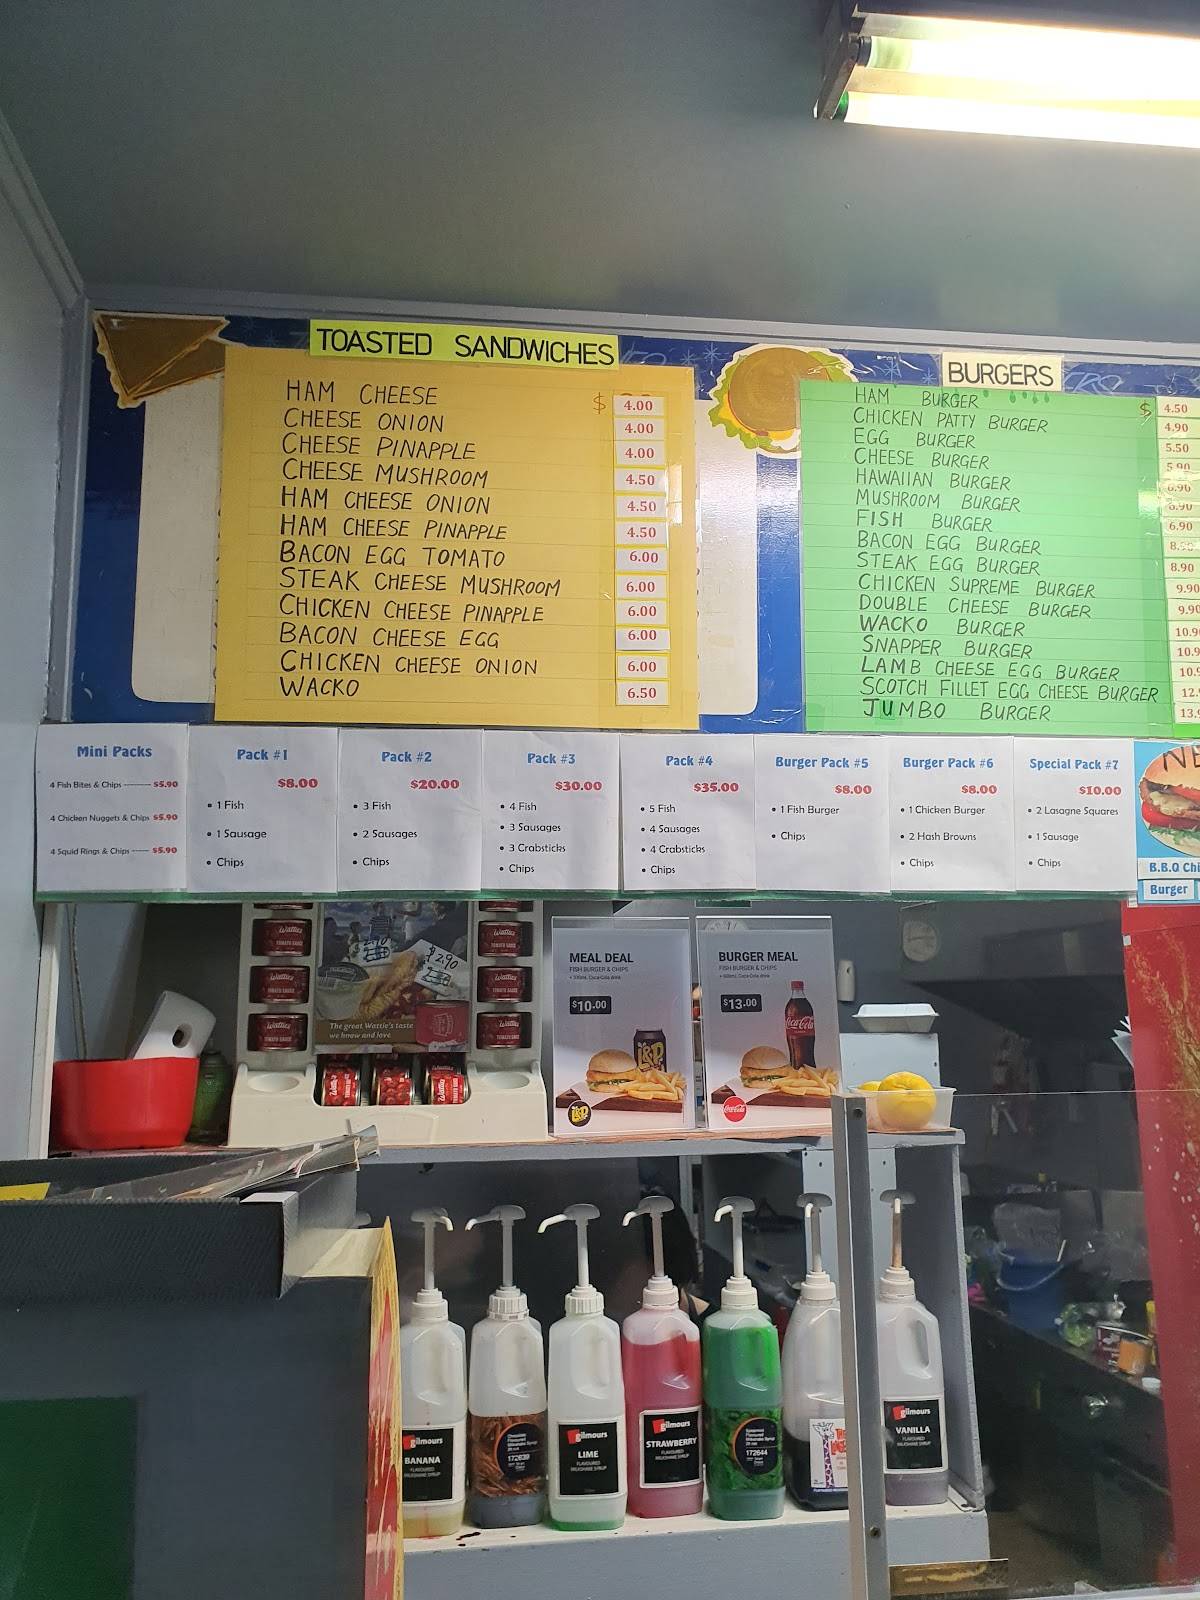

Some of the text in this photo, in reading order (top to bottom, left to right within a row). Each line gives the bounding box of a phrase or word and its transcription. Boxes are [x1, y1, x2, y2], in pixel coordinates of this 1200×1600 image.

[317, 328, 432, 355] TOASTED
[455, 335, 615, 365] SANDWICHES
[949, 362, 1053, 386] BURGERS
[287, 379, 438, 405] HAM CHEESE
[855, 387, 979, 408] HAM BURGER
[593, 393, 606, 414] $
[624, 400, 653, 412] 4.00
[1164, 404, 1188, 413] 4.50
[284, 408, 444, 432] CHEESE ONION
[853, 407, 1048, 432] CHICKEN PATTY BURGER
[624, 422, 653, 434] 4.00
[1165, 423, 1188, 432] 4.90
[854, 428, 975, 448] EGG BURGER
[1166, 444, 1189, 452] 5.50
[856, 468, 1011, 490] HAWAIIAN BURGER
[281, 485, 490, 514] HAM CHEESE ONION
[855, 489, 1020, 512] MUSHROOM BURGER
[626, 500, 656, 513] 4.50
[857, 509, 992, 532] FISH BURGER
[1169, 522, 1193, 531] 6.90
[280, 540, 505, 569] BACON EGG TOMATO
[629, 551, 659, 564] 6.00
[1171, 563, 1194, 572] 8.90
[280, 567, 560, 597] STEAK CHEESE MUSHROOM
[626, 581, 655, 593] 6.00
[858, 573, 1096, 598] CHICKEN SUPREME BURGER
[280, 593, 544, 623] CHICKEN CHEESE PINAPPLE
[627, 605, 657, 618] 6.00
[860, 595, 1091, 619] DOUBLE CHEESE BURGER
[280, 676, 359, 697] WACKO
[861, 677, 1159, 703] SCOTCH FILLET EGG CHEESE BURGER
[627, 686, 657, 699] 6.50
[863, 698, 1051, 721] JUMBO BURGER
[77, 746, 152, 757] Mini Packs
[237, 749, 287, 760] Pack #1
[528, 753, 576, 764] Pack #3
[904, 758, 993, 770] Burger Pack #6
[1030, 759, 1118, 769] Special Pack #7
[278, 778, 318, 788] $8.00
[555, 781, 602, 791] $30.00
[961, 785, 997, 794] $8.00
[1079, 786, 1122, 795] $10.00
[224, 800, 244, 809] Fish
[509, 802, 536, 811] 4 Fish
[915, 806, 950, 814] Chicken
[954, 806, 985, 816] Burger
[1045, 807, 1081, 816] Lasagne
[1084, 807, 1118, 816] Squares
[519, 823, 561, 832] Sausages
[224, 829, 267, 839] Sausage
[909, 833, 976, 841] 2 Hash Browns
[1043, 833, 1078, 842] Sausage
[509, 843, 566, 853] 3 Crabsticks
[217, 858, 244, 867] Chips
[909, 859, 934, 868] Chips
[1038, 859, 1061, 868] Chips
[509, 864, 534, 874] Chips
[1151, 885, 1188, 896] Burger
[570, 953, 633, 963] MEAL DEAL
[719, 952, 798, 961] BURGER MEAL
[572, 1000, 607, 1012] $10.00
[724, 999, 757, 1009] $13.00
[901, 1408, 930, 1418] gilmours
[661, 1421, 690, 1431] gilmours
[896, 1426, 930, 1434] VANILLA
[576, 1432, 608, 1442] gilmours
[646, 1437, 697, 1448] STRAWBERRY
[411, 1438, 443, 1448] gilmours
[405, 1456, 440, 1464] BANANA
